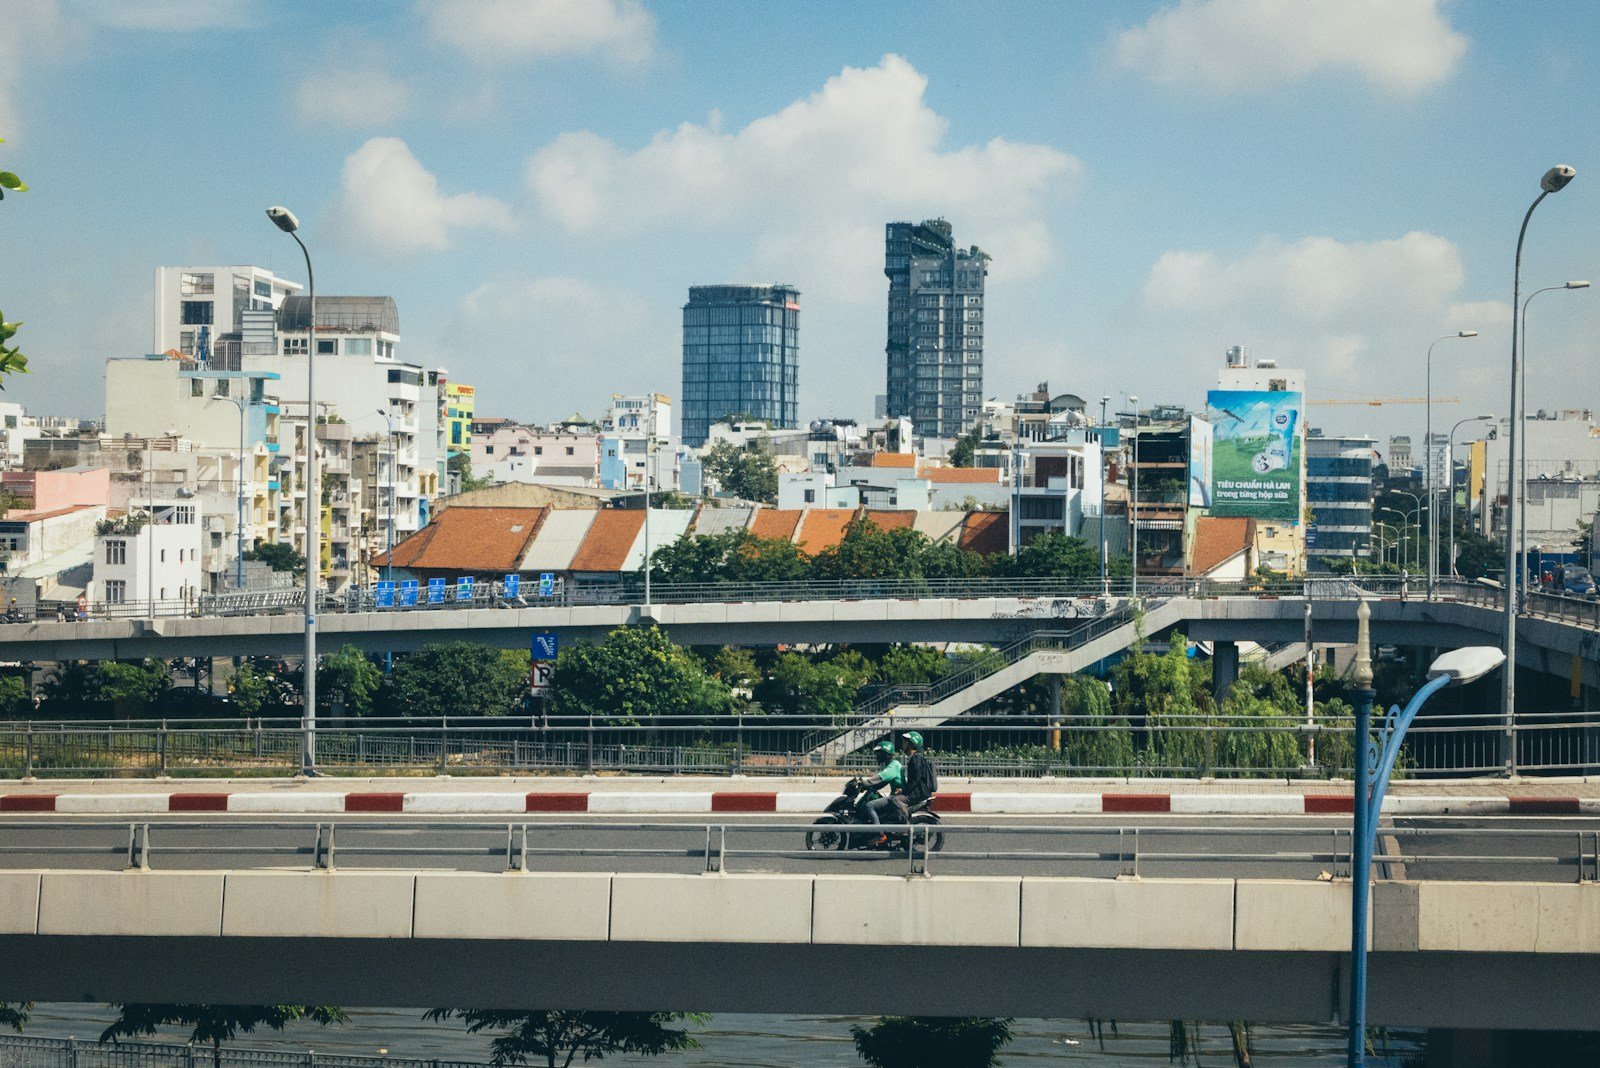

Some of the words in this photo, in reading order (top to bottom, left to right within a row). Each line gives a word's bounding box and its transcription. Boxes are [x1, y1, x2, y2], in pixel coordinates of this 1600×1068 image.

[1216, 480, 1234, 489] TIÊU
[1263, 480, 1275, 489] HÀ
[1275, 482, 1291, 490] LAN
[1216, 490, 1238, 499] trong
[1239, 489, 1257, 499] từng
[1258, 490, 1273, 500] hộp
[1273, 490, 1288, 499] sữa
